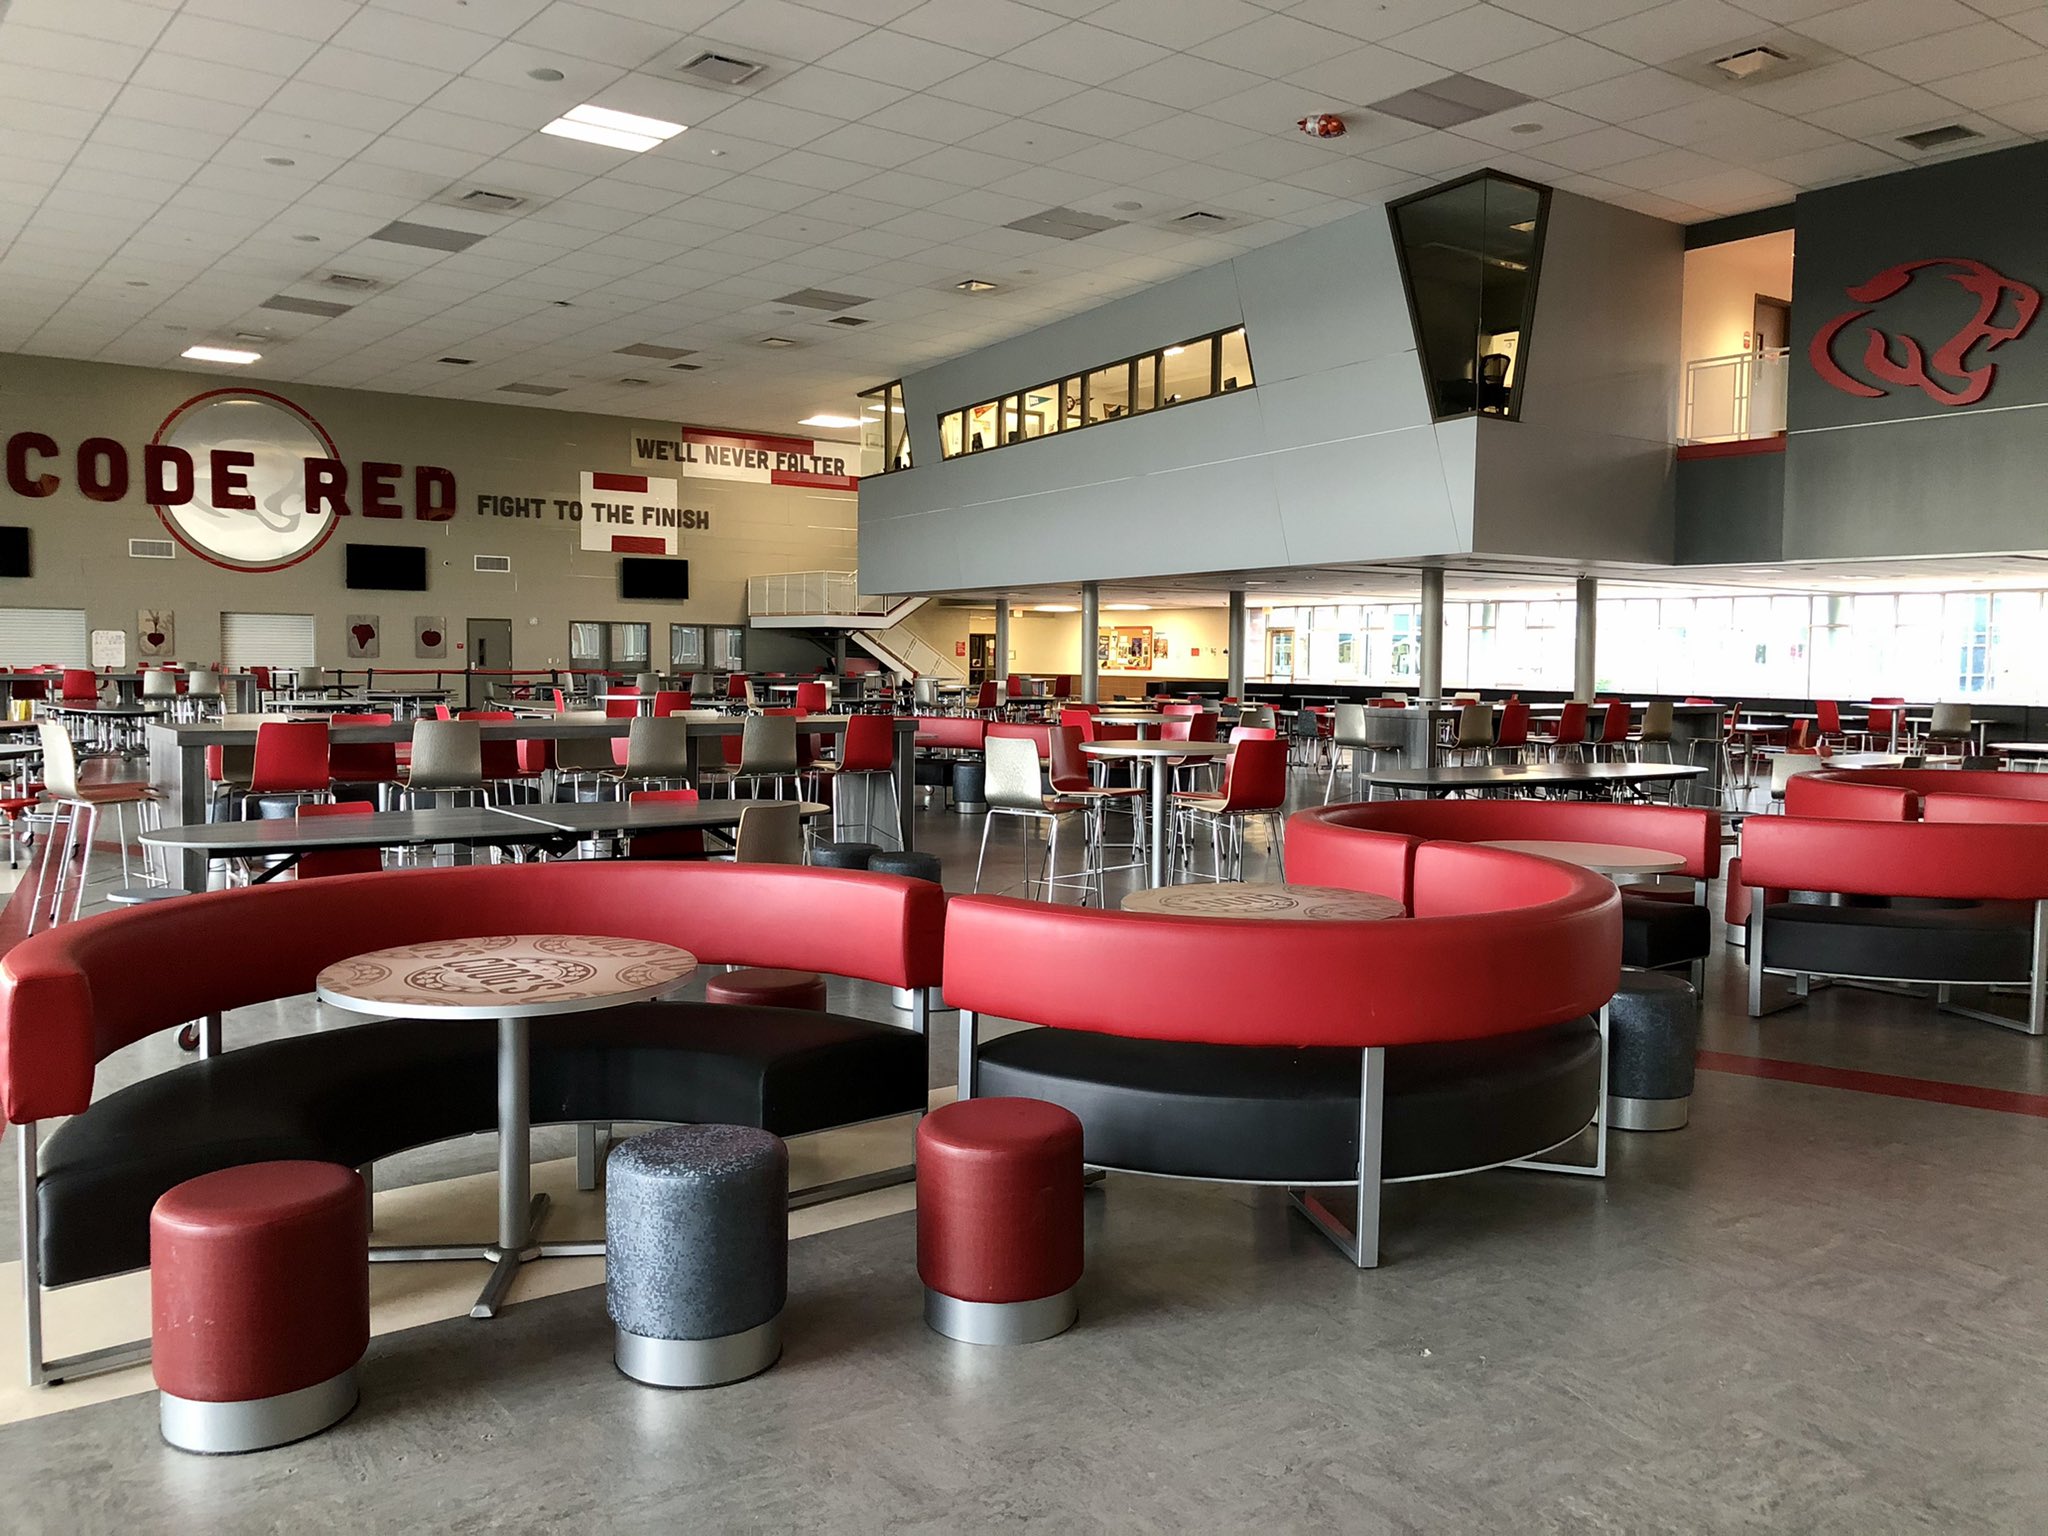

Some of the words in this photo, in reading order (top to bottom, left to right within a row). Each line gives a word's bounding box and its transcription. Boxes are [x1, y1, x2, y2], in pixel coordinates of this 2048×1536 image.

[6, 431, 256, 511] CODE
[303, 456, 457, 522] RED
[636, 437, 698, 464] WE'LL
[705, 445, 769, 470] NEVER
[776, 452, 846, 477] FALTER
[477, 494, 546, 519] FIGHT
[554, 500, 583, 522] TO
[591, 502, 635, 525] THE
[642, 506, 710, 530] FINISH
